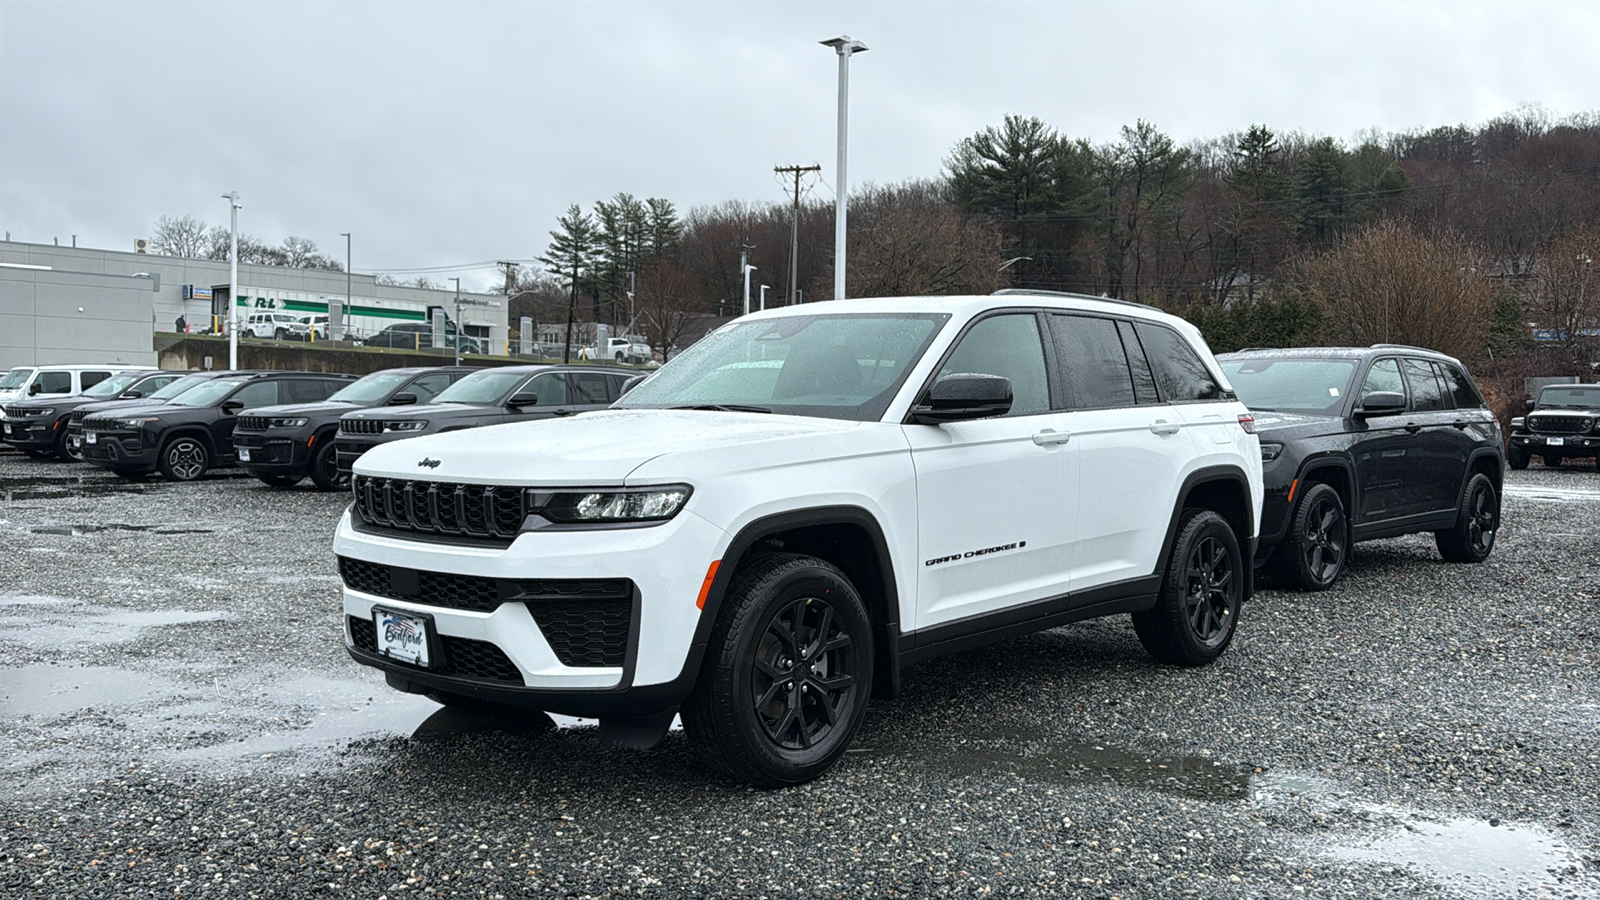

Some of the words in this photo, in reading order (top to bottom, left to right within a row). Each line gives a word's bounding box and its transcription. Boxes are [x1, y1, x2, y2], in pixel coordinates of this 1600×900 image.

[418, 457, 441, 469] Jeep
[925, 553, 962, 566] GRAND
[963, 542, 1017, 558] CHEROKEE
[384, 623, 423, 649] Bedford
